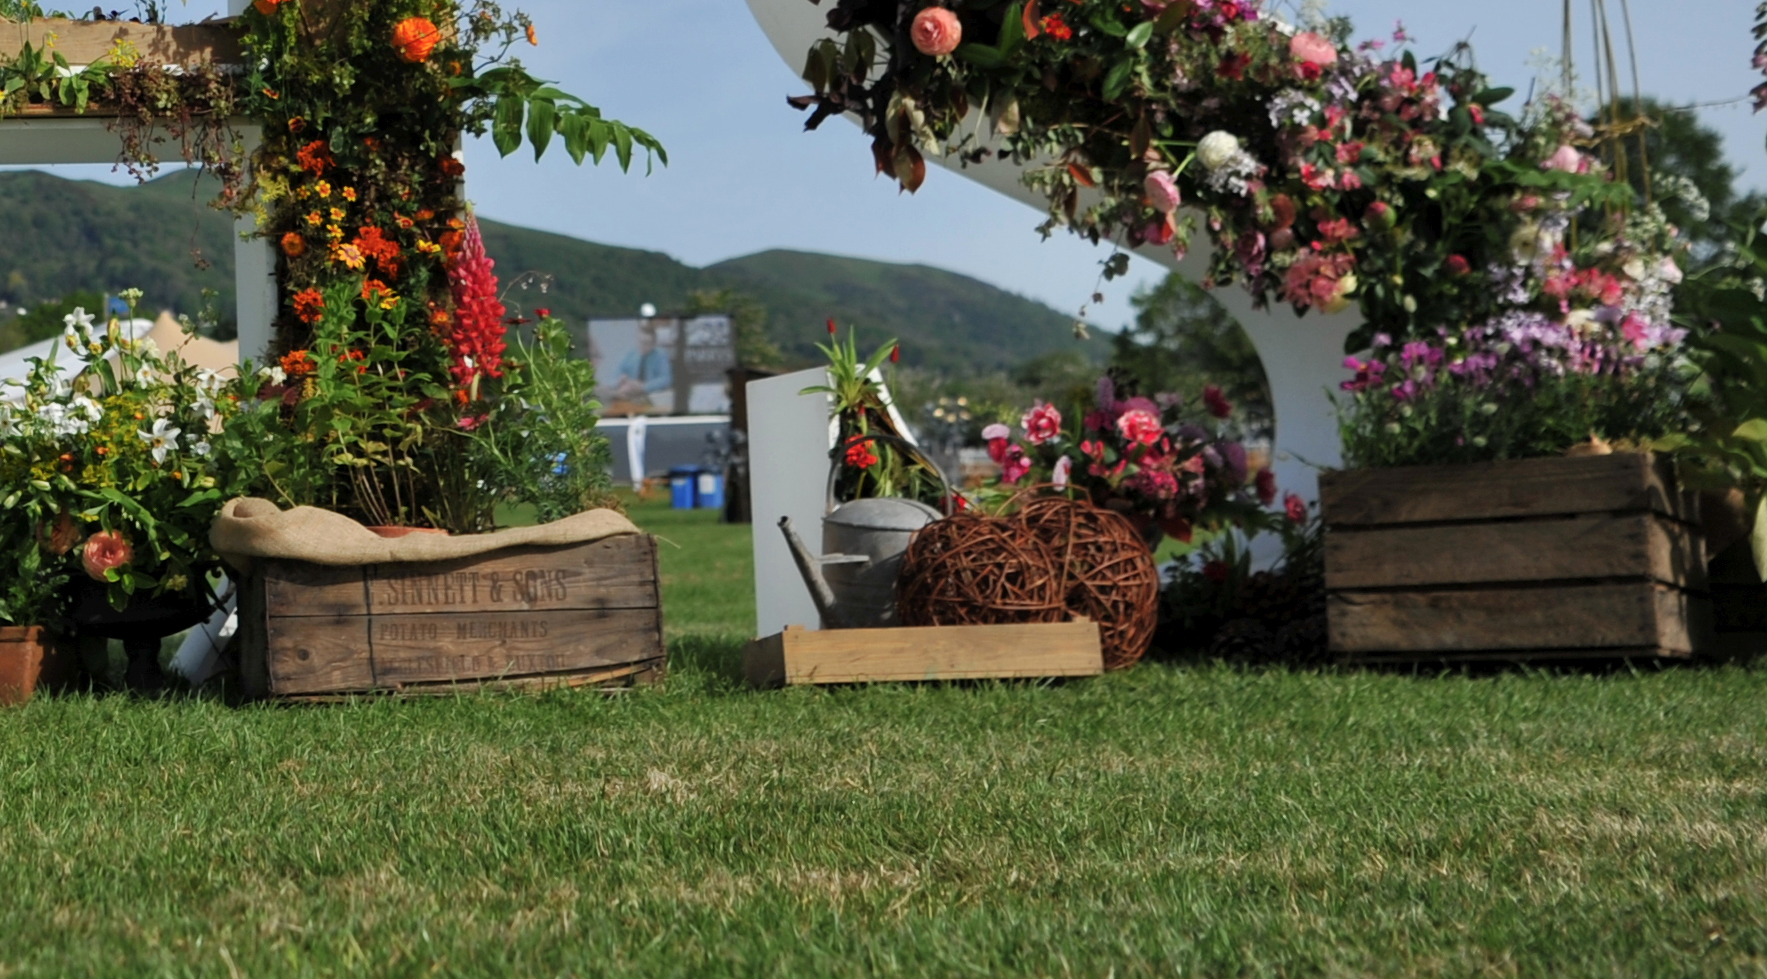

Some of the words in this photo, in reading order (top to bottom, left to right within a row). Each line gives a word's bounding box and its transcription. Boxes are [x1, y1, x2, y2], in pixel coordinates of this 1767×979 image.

[489, 571, 504, 603] &
[512, 569, 568, 604] SONS
[379, 623, 438, 641] POTATO
[456, 620, 549, 640] MERCHANTS
